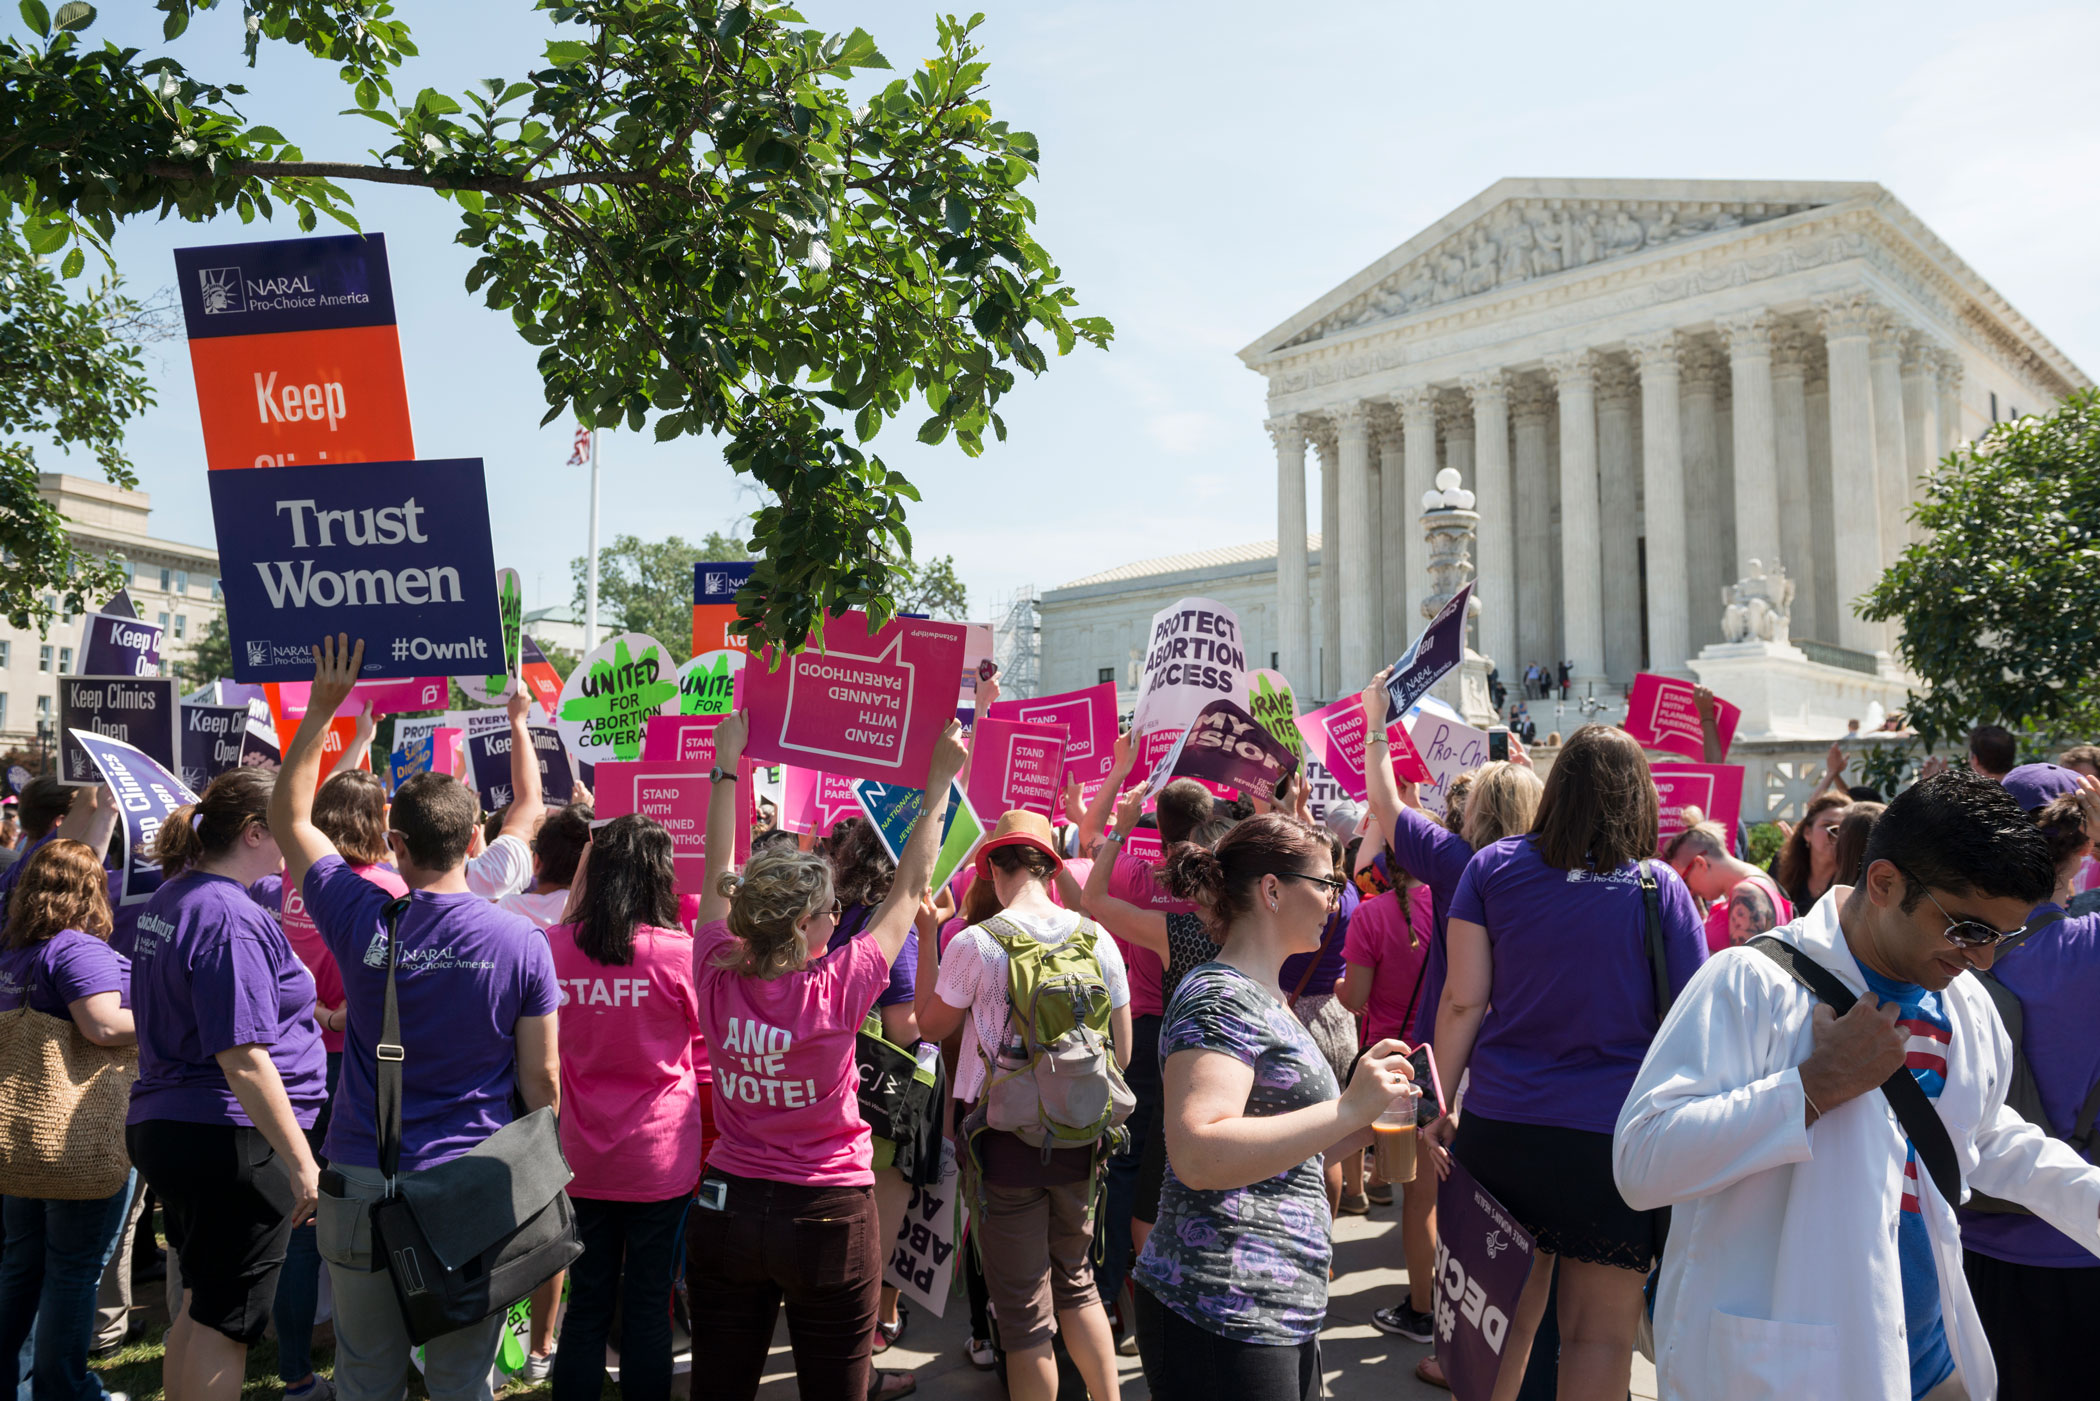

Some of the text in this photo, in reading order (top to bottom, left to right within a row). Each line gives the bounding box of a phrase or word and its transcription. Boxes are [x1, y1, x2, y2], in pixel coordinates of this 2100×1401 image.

[247, 276, 314, 296] NARAL
[250, 292, 369, 311] Pro-Choice America
[254, 371, 347, 431] Keep
[276, 497, 428, 548] Trust
[252, 560, 465, 608] Women
[1153, 610, 1235, 645] PROTECT
[110, 622, 151, 655] Keep
[391, 636, 488, 661] #OwnIt
[273, 645, 312, 657] NARAL
[1144, 637, 1245, 675] ABORTION
[581, 658, 660, 698] UNITED
[798, 662, 902, 690] PARENTHOOD
[1147, 663, 1233, 696] ACCESS
[1405, 665, 1433, 692] NARAL
[1409, 660, 1453, 701] Pro-Choice America
[680, 675, 734, 698] UNITE
[71, 683, 156, 713] Keep Clinics
[610, 693, 640, 712] FOR
[694, 700, 723, 712] FOR
[828, 686, 900, 709] PLANNED
[1661, 702, 1685, 712] WITH
[1663, 692, 1693, 705] STAND
[189, 709, 228, 738] Keep
[582, 703, 662, 732] ABORTION
[859, 710, 897, 729] WITH
[1332, 716, 1363, 736] STAND
[1659, 709, 1700, 726] PLANNED
[323, 730, 342, 752] en
[402, 723, 446, 739] PROTE
[578, 729, 647, 748] COVERA
[845, 728, 894, 747] STAND
[1338, 730, 1361, 746] WITH
[484, 735, 512, 757] Kee
[685, 737, 716, 748] STAN
[1015, 747, 1045, 758] STAND
[1344, 741, 1366, 756] PLAN
[214, 740, 240, 767] Open
[685, 751, 712, 760] WITH
[1014, 759, 1038, 770] WITH
[101, 753, 151, 812] Clinics
[825, 777, 856, 788] PLAN
[1012, 771, 1049, 786] PLANNED
[1655, 784, 1674, 793] AND
[642, 789, 680, 799] STAND
[911, 795, 921, 809] OF
[642, 804, 672, 814] WITH
[881, 791, 914, 831] NATIONAL
[656, 819, 695, 830] ANNED
[899, 815, 920, 844] JEWIS
[1133, 847, 1160, 857] STAND
[403, 947, 455, 962] NARAL
[400, 959, 495, 971] Pro-Choice America
[557, 978, 650, 1007] STAFF
[722, 1017, 792, 1055] AND
[718, 1067, 817, 1108] VOTE!
[1512, 1228, 1529, 1254] WHOLE
